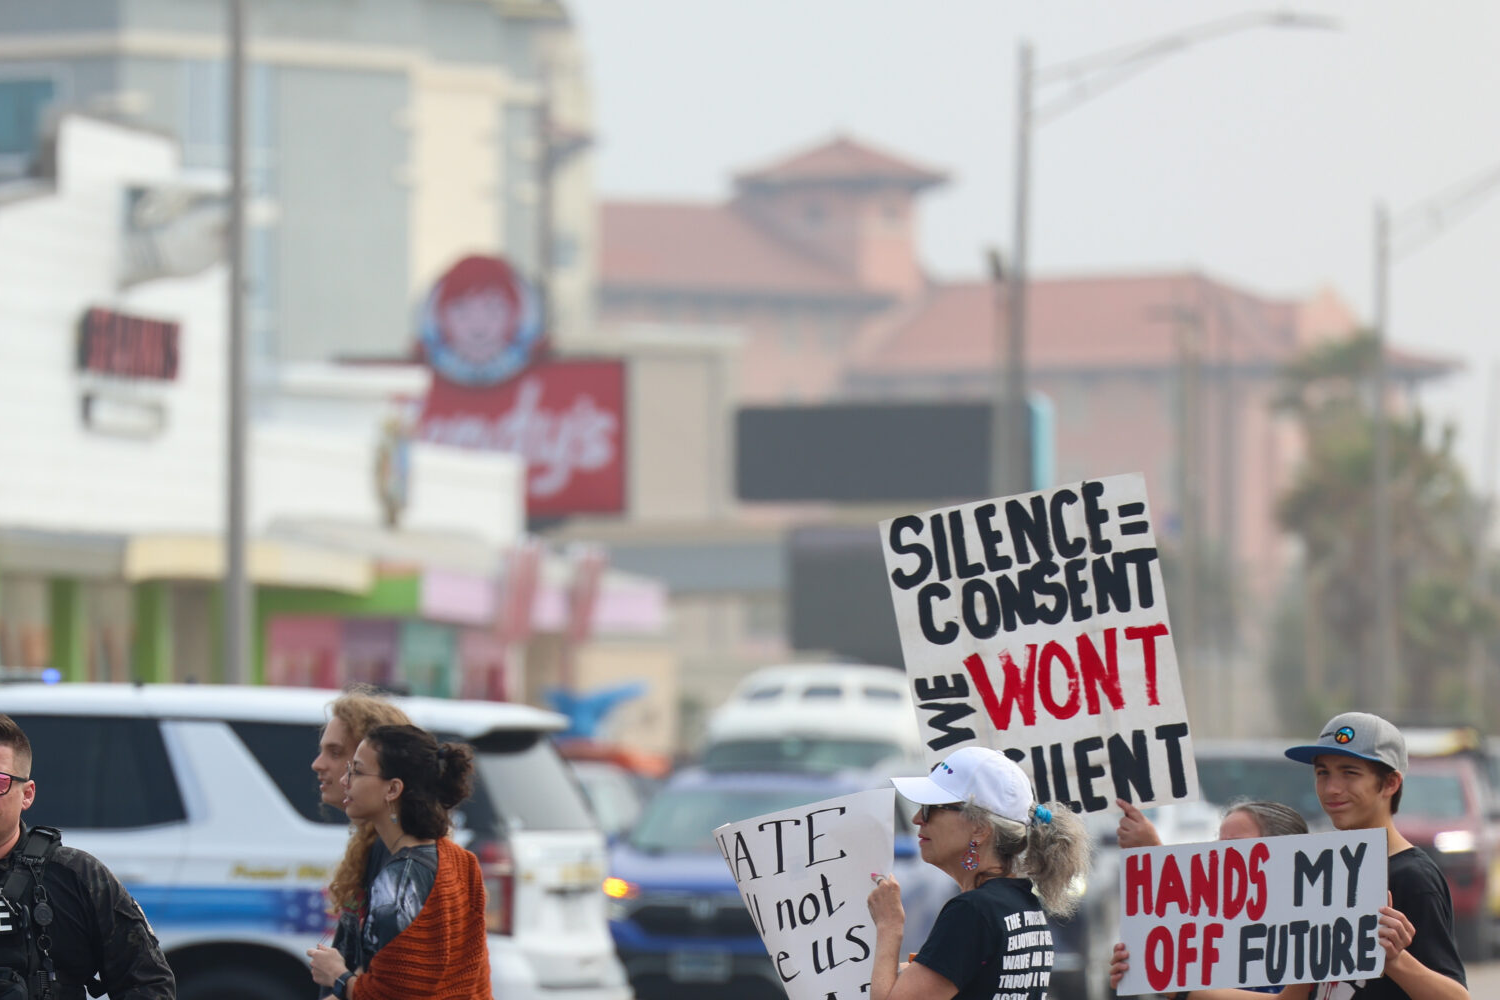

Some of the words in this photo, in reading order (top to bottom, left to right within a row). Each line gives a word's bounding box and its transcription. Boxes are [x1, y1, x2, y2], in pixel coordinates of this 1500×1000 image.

[916, 547, 1158, 645] CONSENT
[914, 673, 978, 751] WE
[962, 621, 1169, 731] WONT
[776, 873, 846, 932] not
[1125, 842, 1270, 921] HANDS
[1293, 842, 1368, 908] MY
[811, 924, 871, 975] us
[1144, 922, 1224, 991] OFF
[1238, 914, 1378, 984] FUTURE
